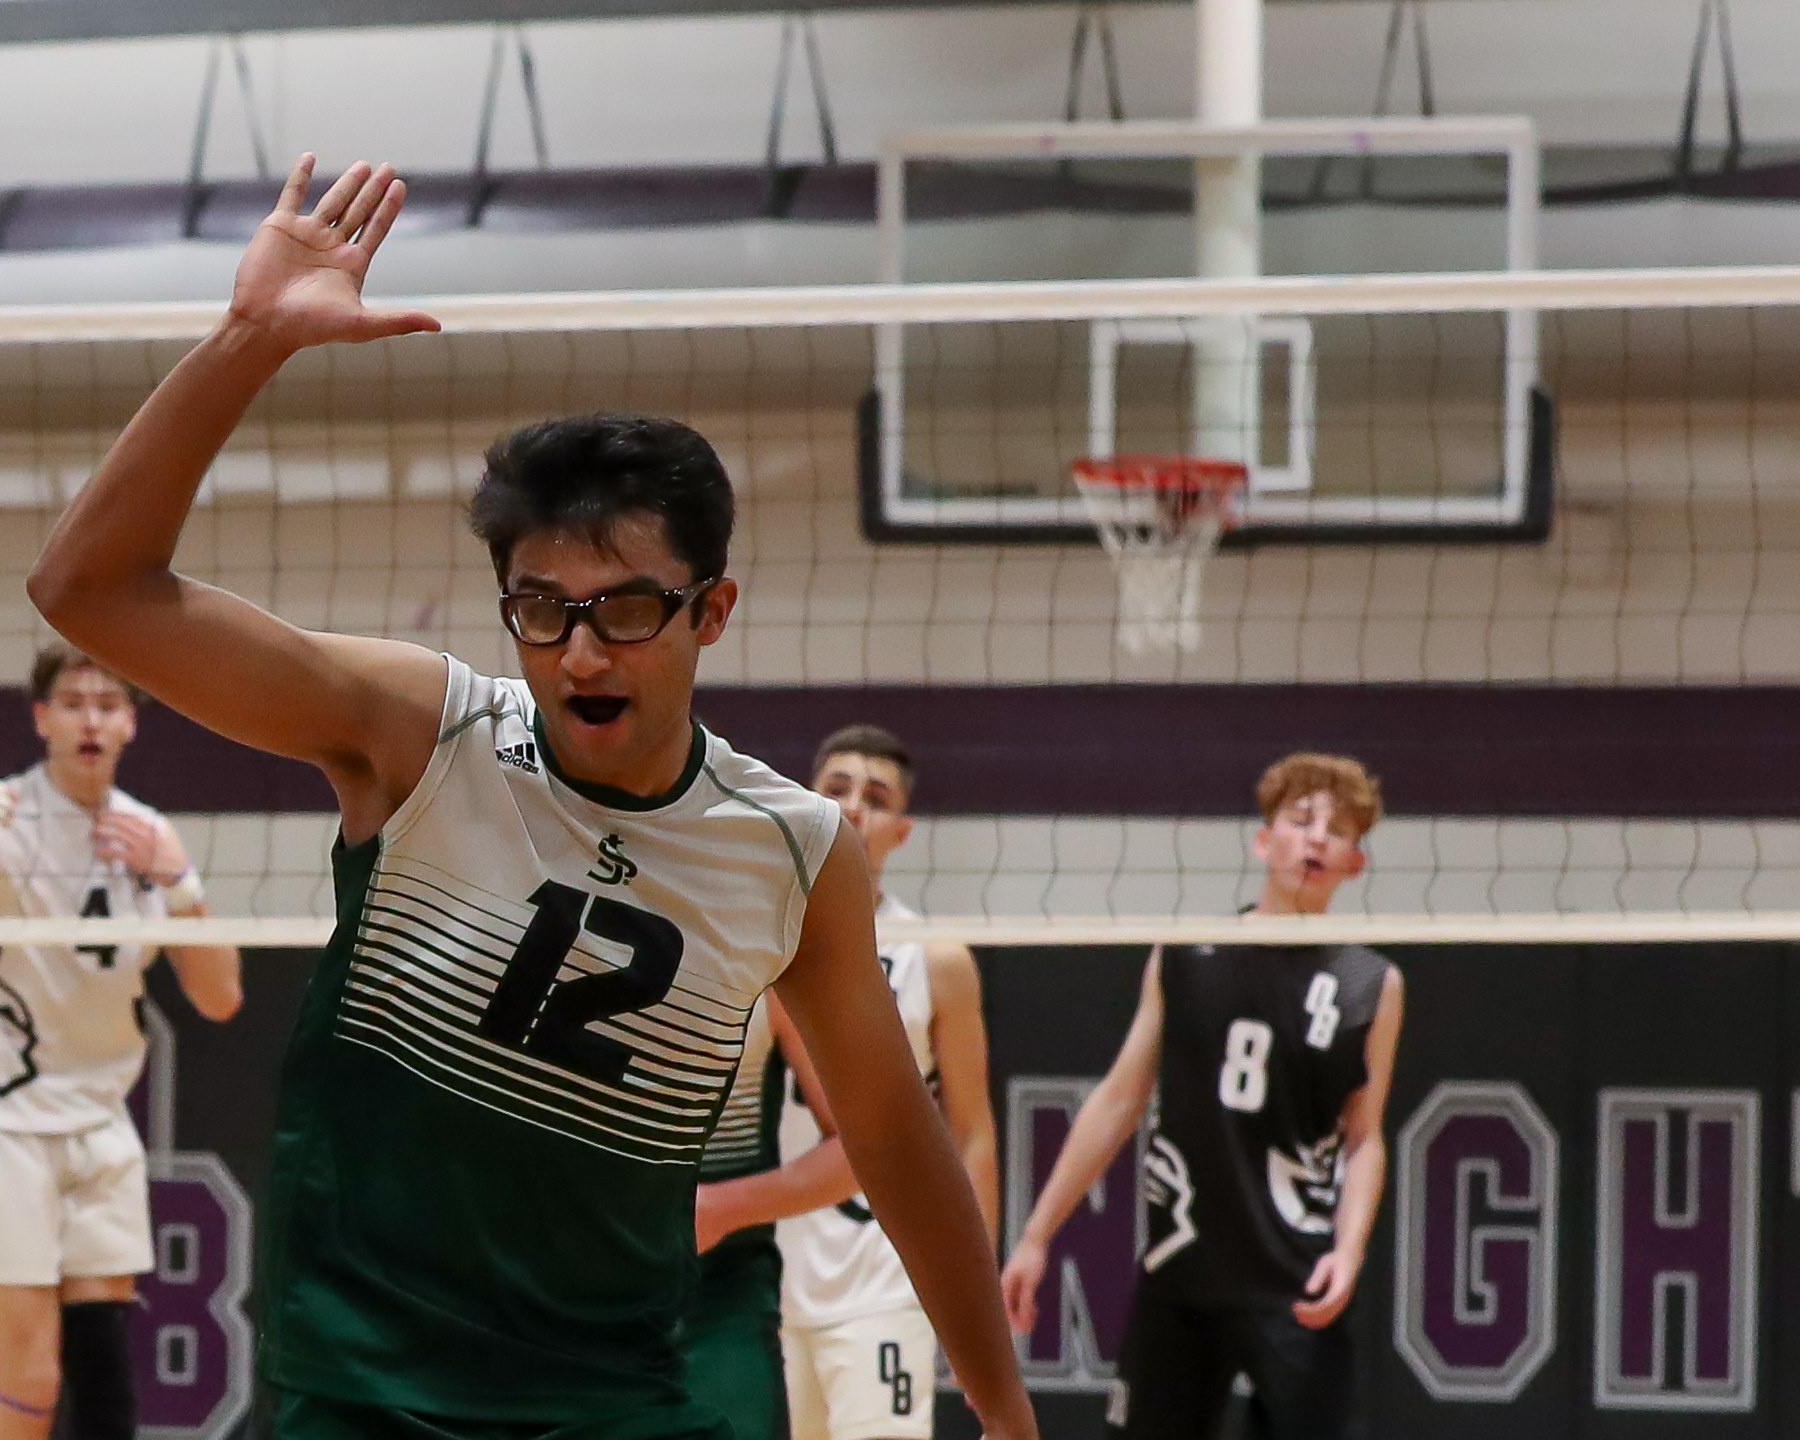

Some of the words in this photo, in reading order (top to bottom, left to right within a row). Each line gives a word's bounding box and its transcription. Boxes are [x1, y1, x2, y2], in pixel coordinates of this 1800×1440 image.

[75, 885, 117, 968] 4
[479, 878, 684, 1089] 12
[1219, 1017, 1274, 1114] 8
